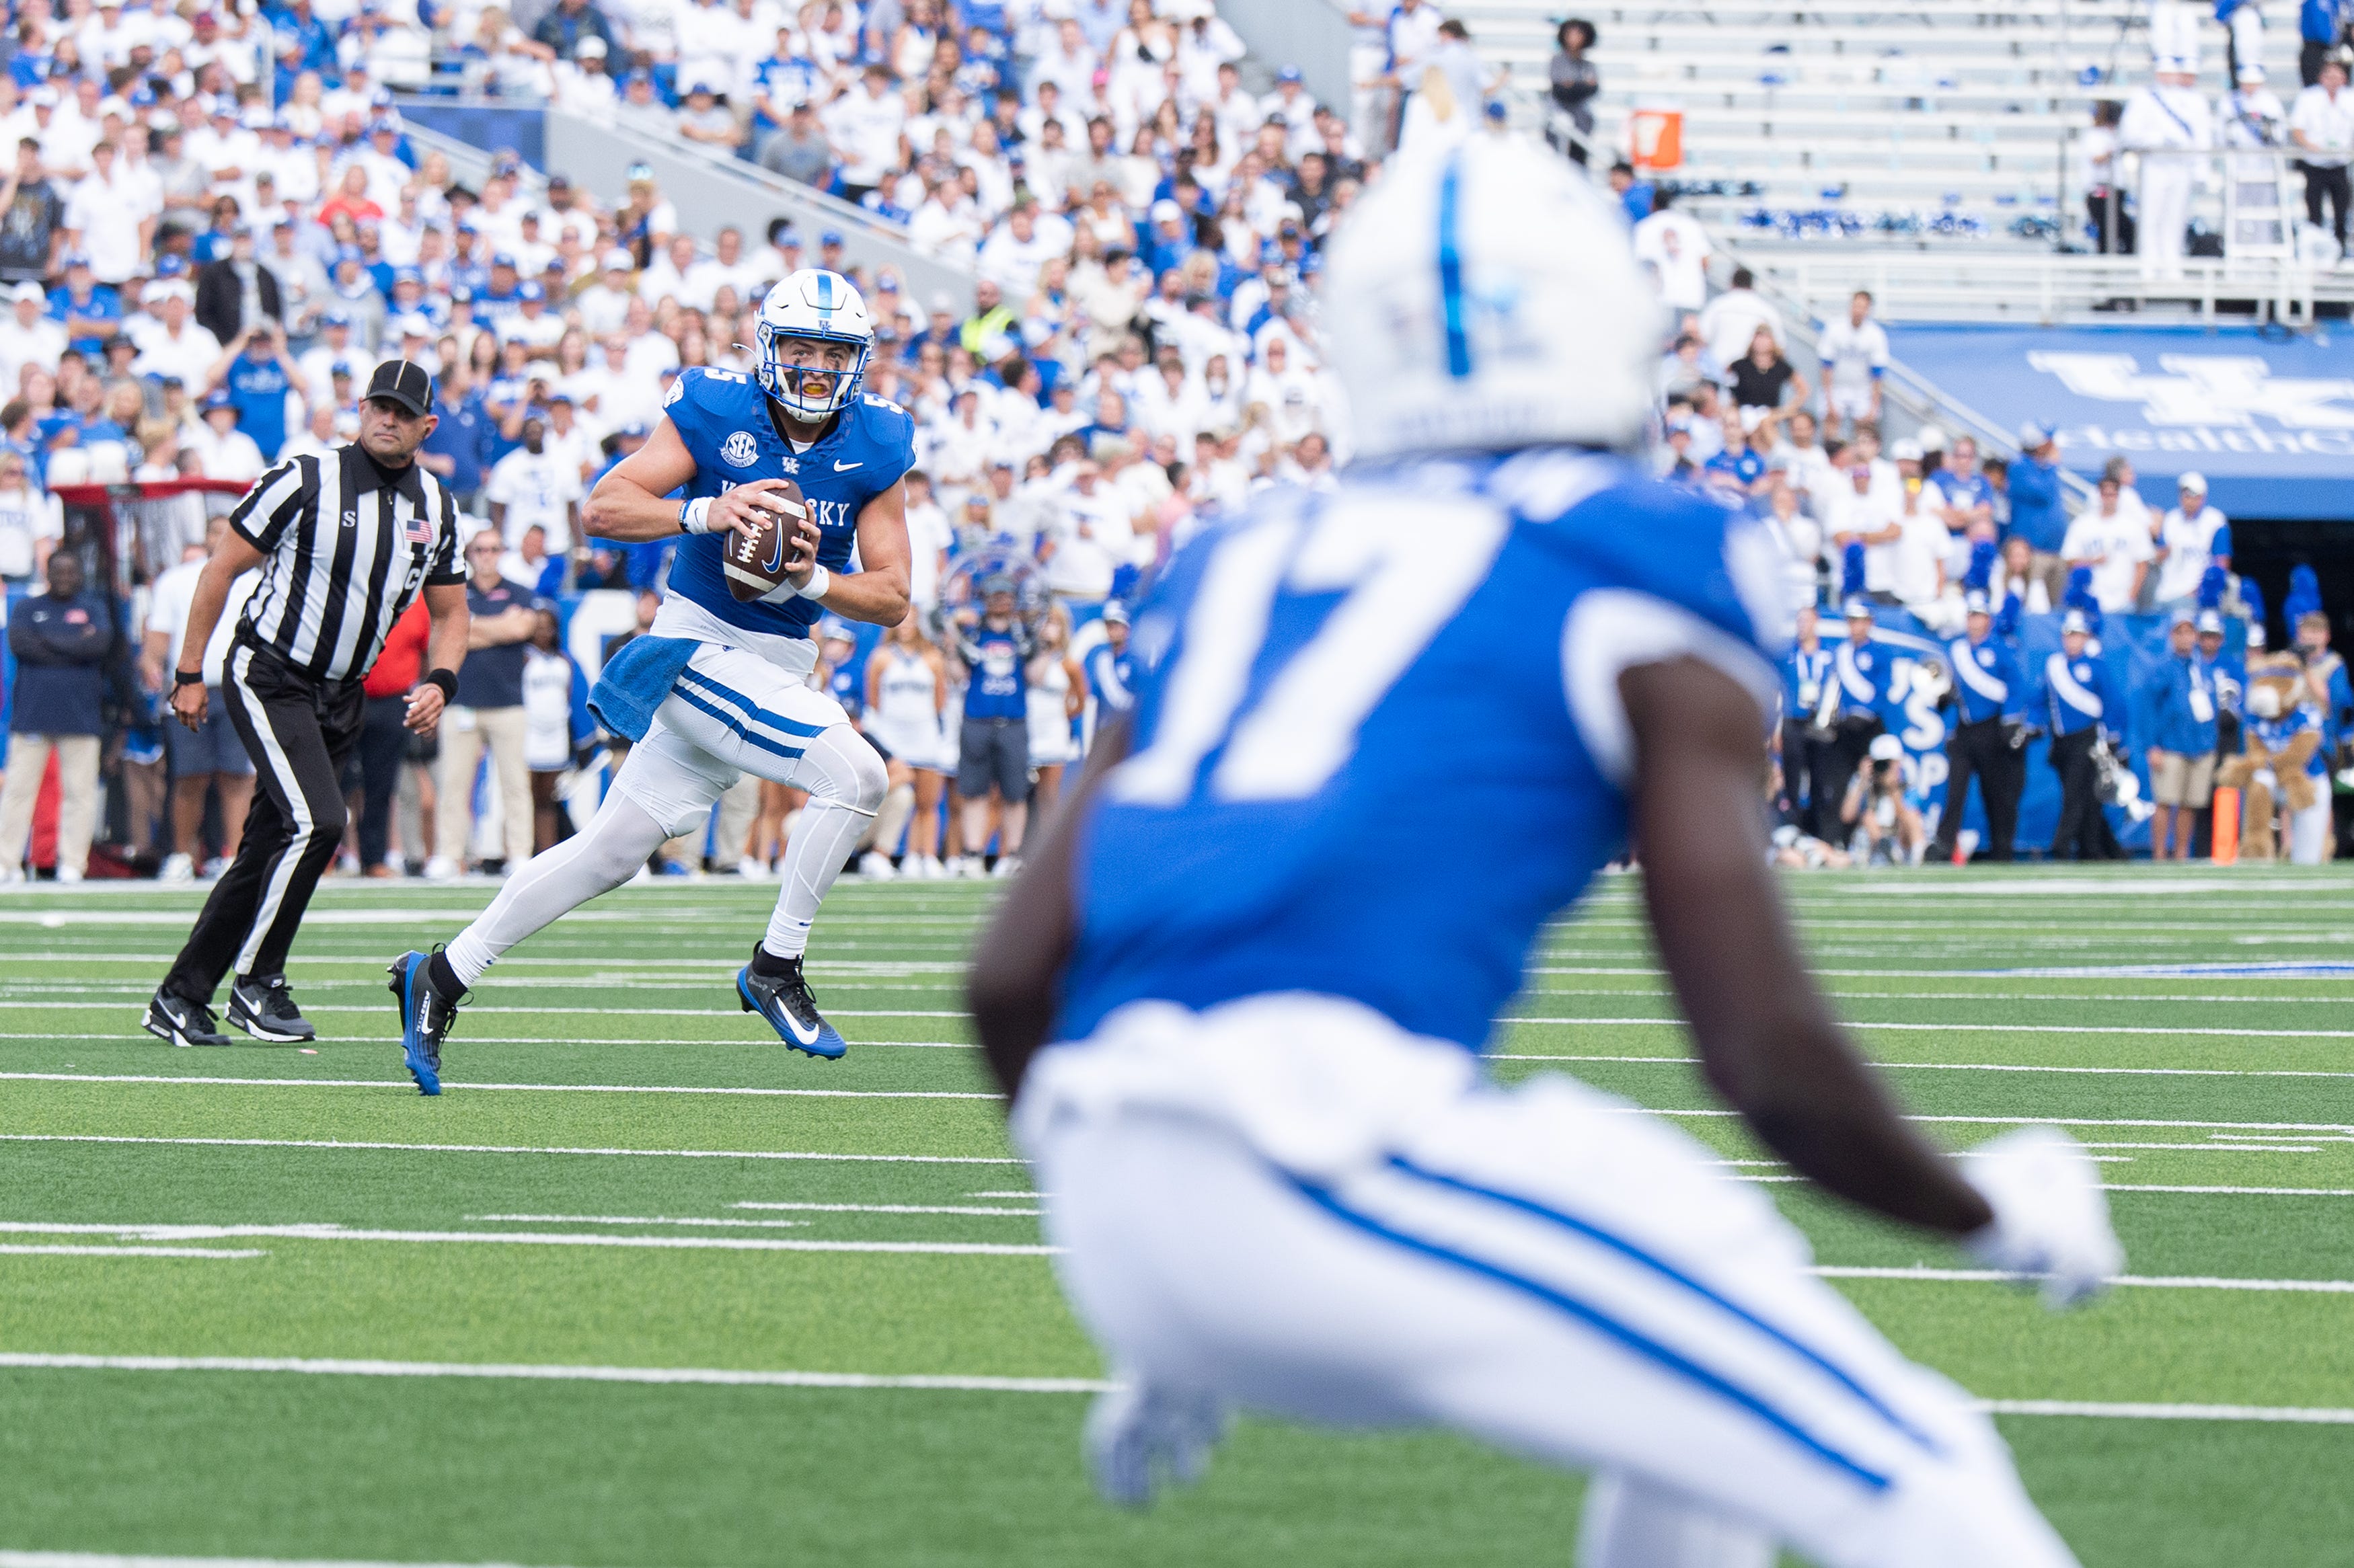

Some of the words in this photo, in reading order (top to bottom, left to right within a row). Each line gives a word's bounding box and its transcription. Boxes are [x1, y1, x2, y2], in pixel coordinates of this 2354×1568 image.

[704, 368, 747, 385] 5
[728, 433, 755, 459] SEC
[782, 457, 800, 475] UK
[342, 510, 356, 528] S
[404, 568, 422, 590] C
[1110, 491, 1511, 805] 17
